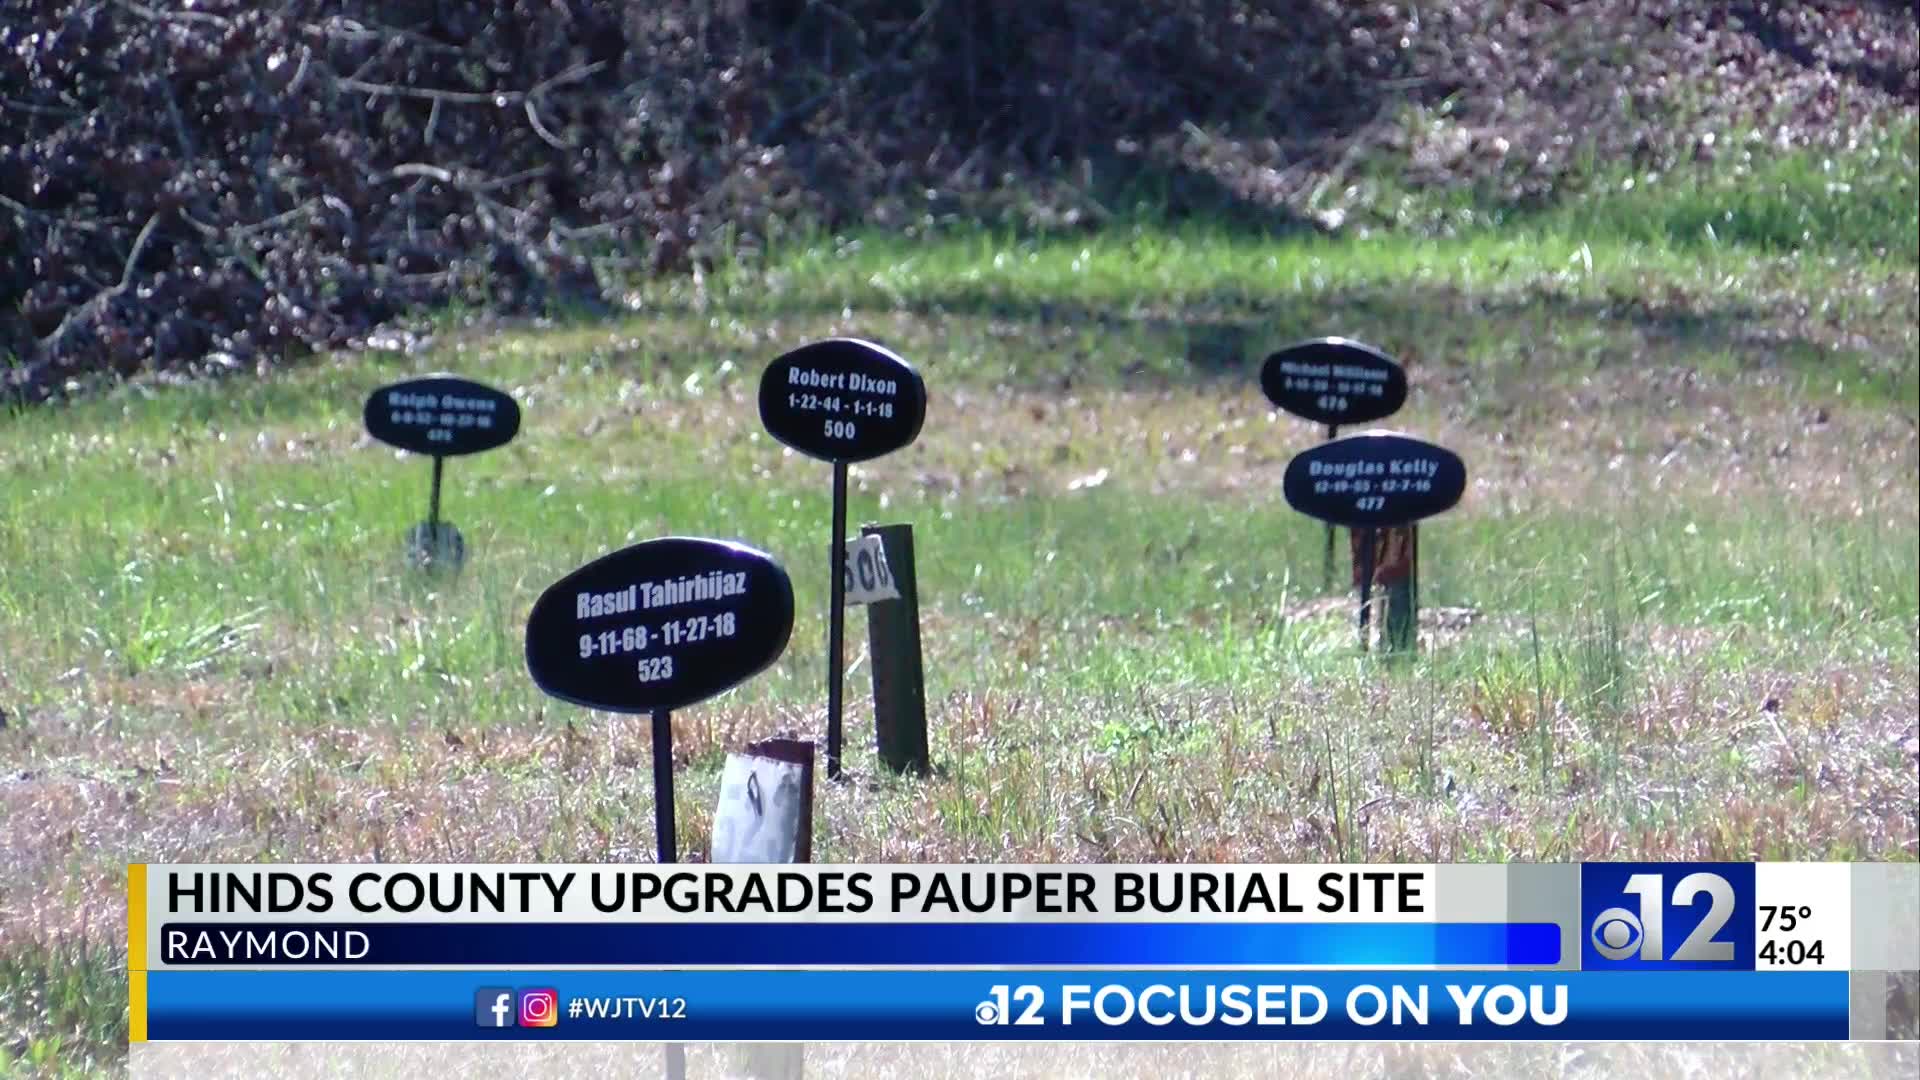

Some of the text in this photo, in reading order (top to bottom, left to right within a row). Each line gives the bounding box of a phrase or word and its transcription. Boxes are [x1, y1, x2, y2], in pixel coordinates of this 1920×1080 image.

[788, 366, 898, 395] Robert Dixon
[788, 392, 840, 412] 1-22-44
[853, 398, 894, 418] 1-1-18
[823, 419, 856, 440] 500
[1309, 458, 1438, 477] Douglas Kelly
[1356, 496, 1386, 511] 477
[576, 572, 745, 620] Rasul Tahirhijaz
[579, 625, 648, 659] 9-11-68
[661, 612, 736, 646] 11-27-18
[638, 656, 673, 683] 523
